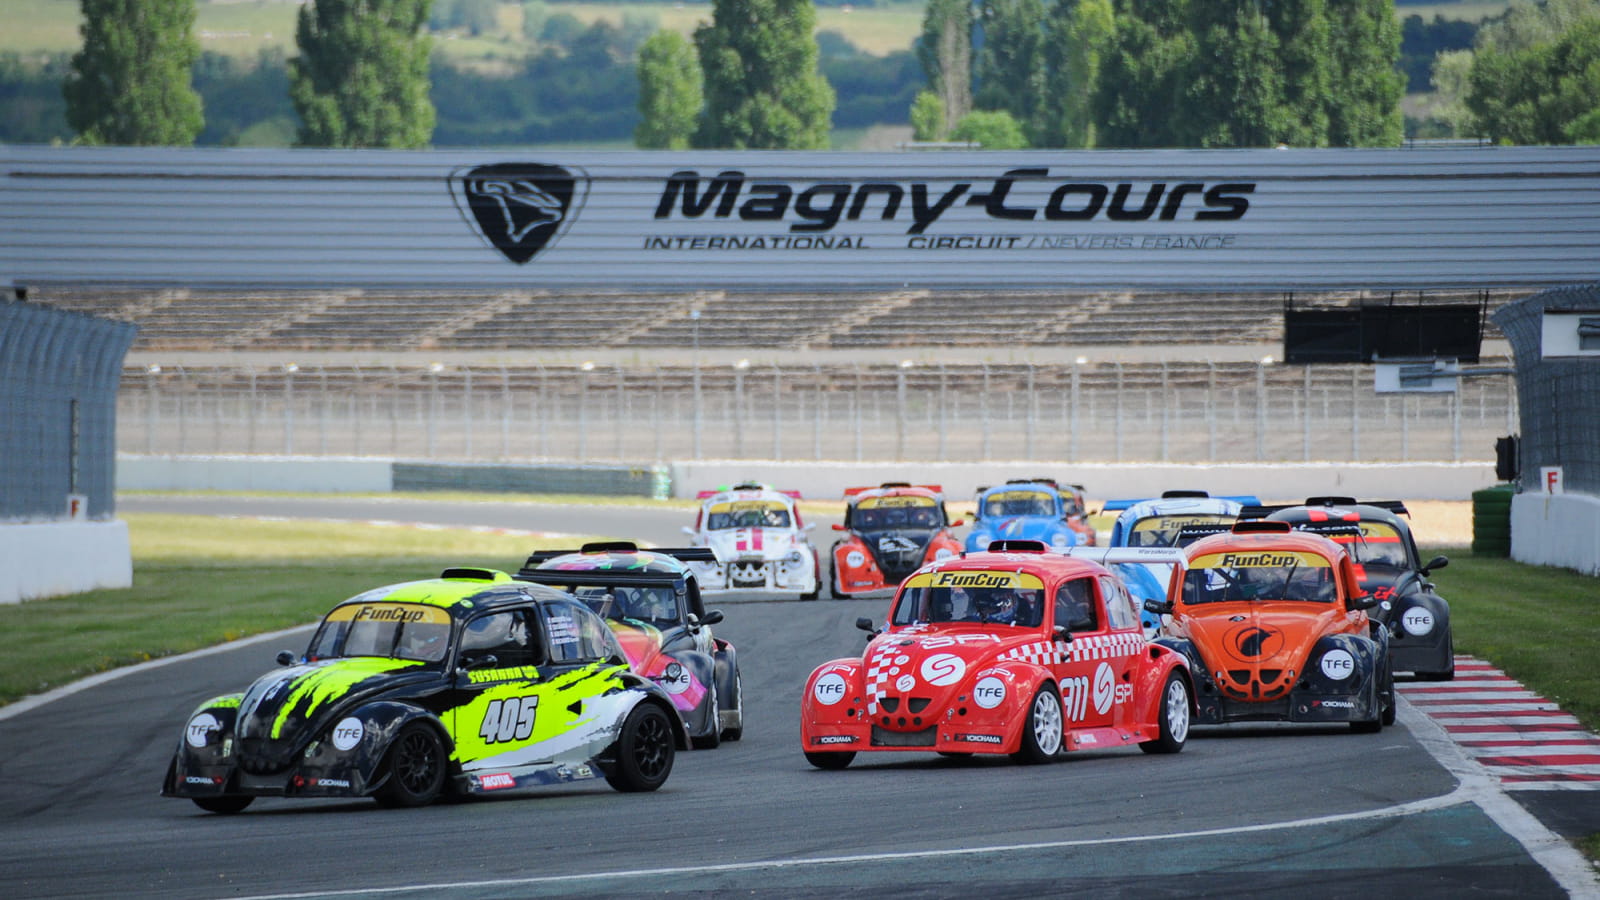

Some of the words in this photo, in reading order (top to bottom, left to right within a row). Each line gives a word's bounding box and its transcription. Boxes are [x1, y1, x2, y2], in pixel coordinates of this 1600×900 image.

[654, 168, 1256, 235] Magny-Cours
[643, 237, 870, 250] INTERNATIONAL
[908, 237, 1021, 250] CIRCUIT
[1547, 472, 1558, 494] F
[1222, 553, 1295, 568] FunCup
[939, 573, 1011, 588] FunCup
[359, 605, 425, 622] FunCup
[1406, 616, 1430, 625] TFE
[920, 633, 1001, 650] SPI
[819, 664, 857, 676] SPI
[1325, 659, 1351, 669] TFE
[976, 668, 1016, 681] SPI
[817, 684, 843, 694] TFE
[976, 687, 1003, 698] TFE
[1115, 683, 1134, 704] SPI
[478, 695, 539, 745] 405
[336, 728, 361, 739] TFE
[820, 735, 852, 744] YOKOHAMA
[966, 735, 1001, 744] YOKOHAMA
[482, 774, 513, 787] MOTUL
